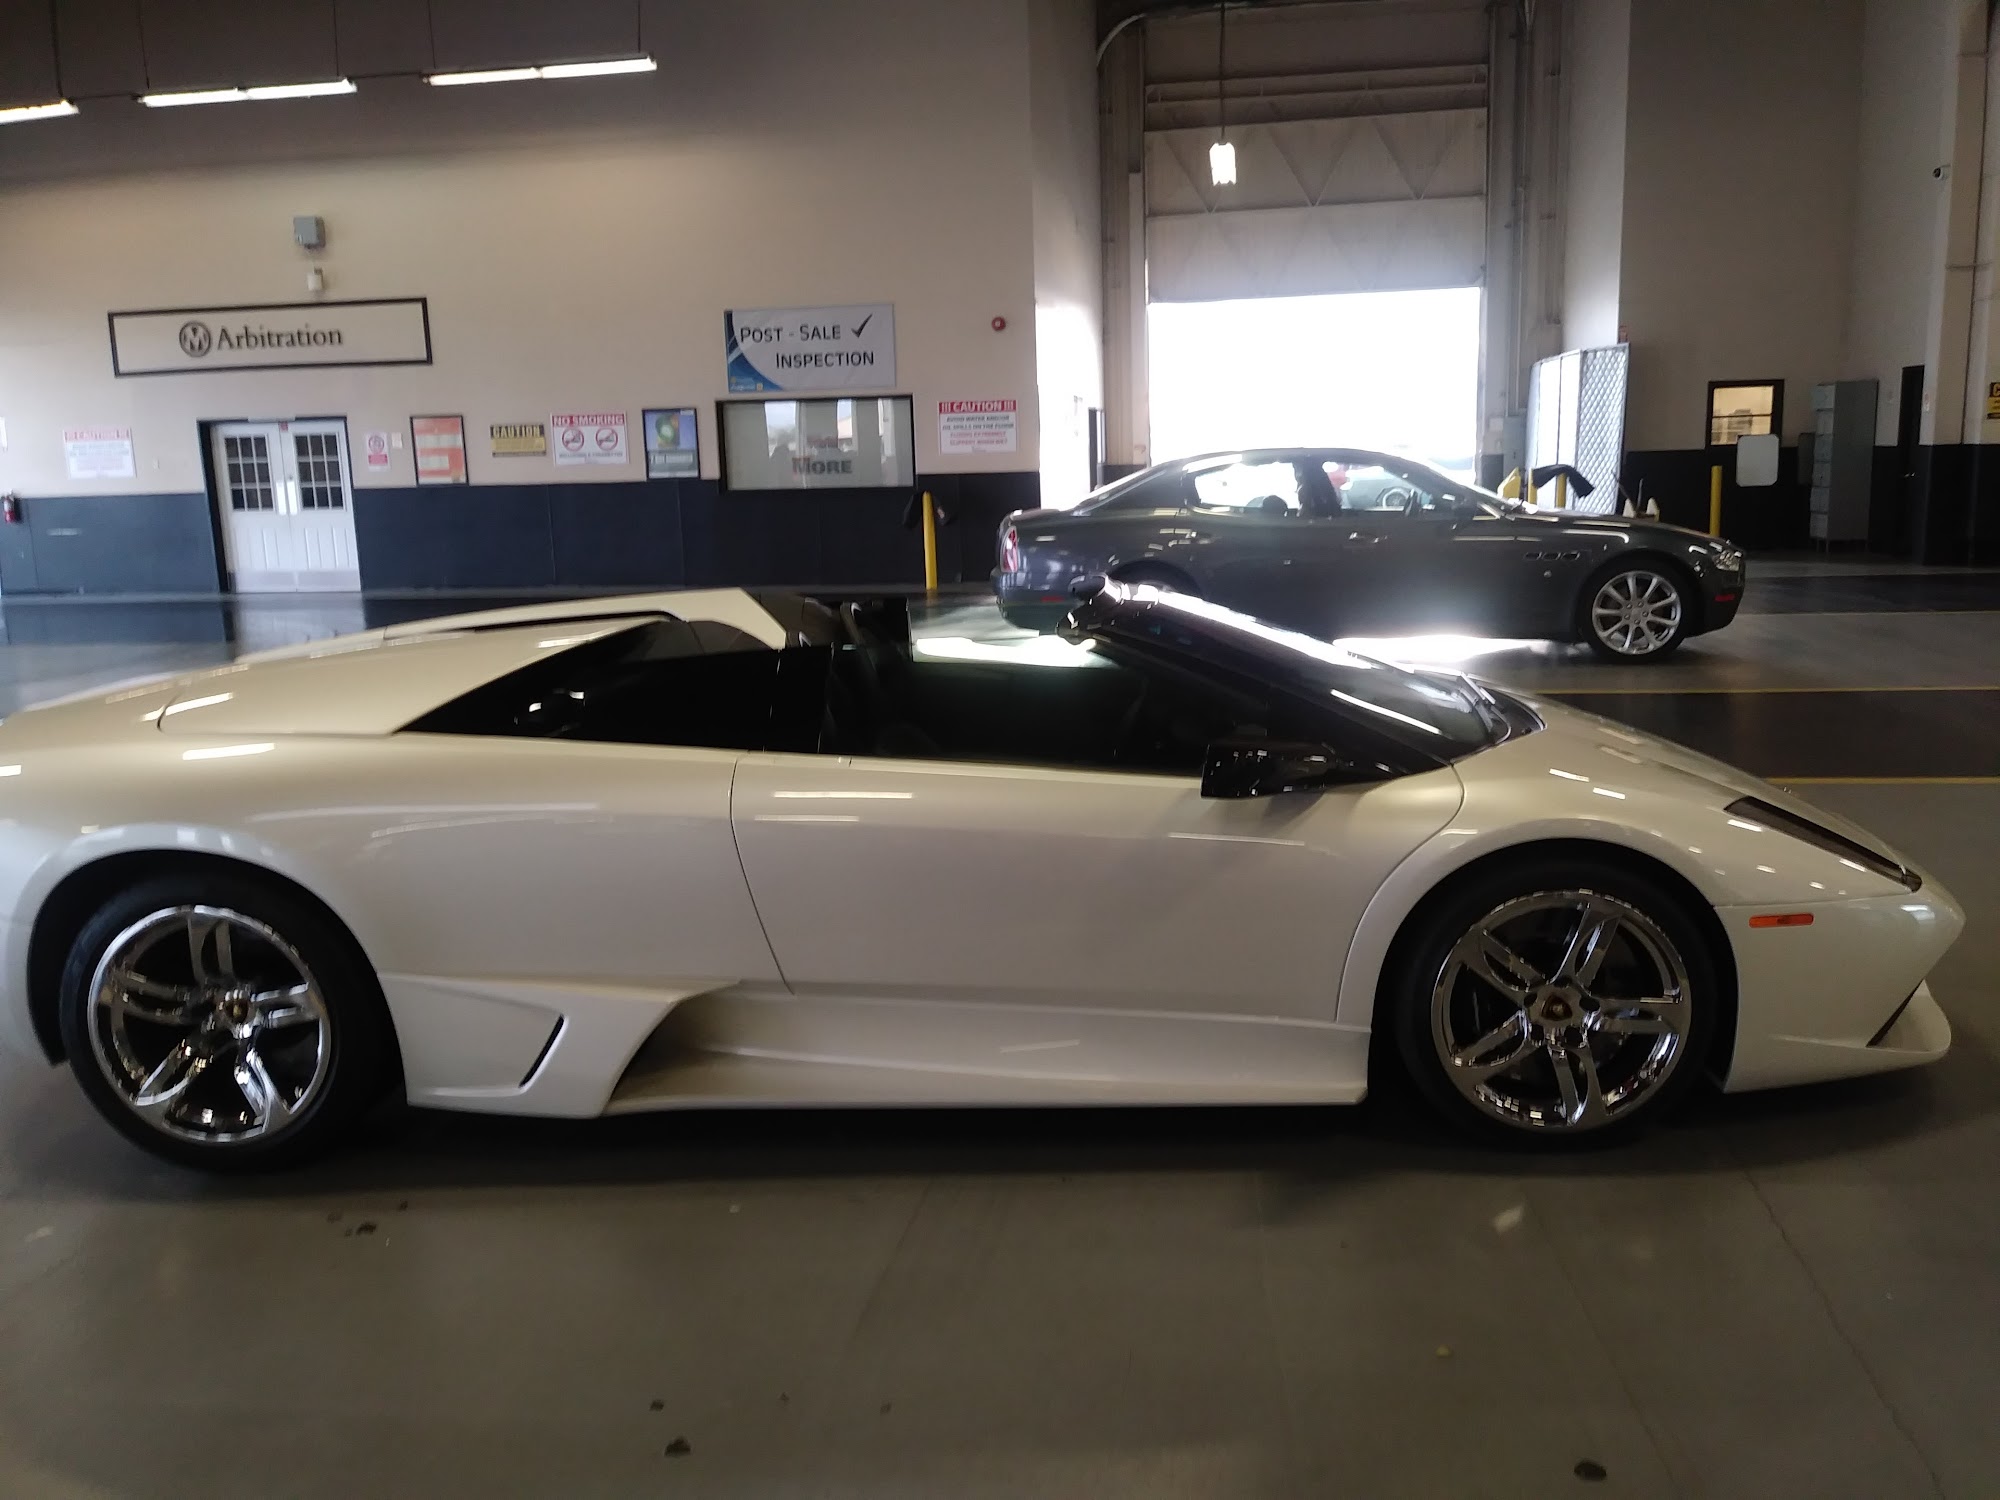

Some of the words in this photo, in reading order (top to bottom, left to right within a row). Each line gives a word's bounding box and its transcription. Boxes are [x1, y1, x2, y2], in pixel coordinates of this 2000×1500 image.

[217, 322, 342, 351] Arbitration
[740, 326, 783, 343] POST
[799, 323, 841, 342] SALE
[776, 351, 874, 369] INSPECTION
[952, 400, 1002, 413] CAUTION
[553, 415, 570, 427] NO
[572, 414, 624, 427] SMOKING
[492, 425, 541, 438] CAUTION
[792, 457, 853, 474] MORE
